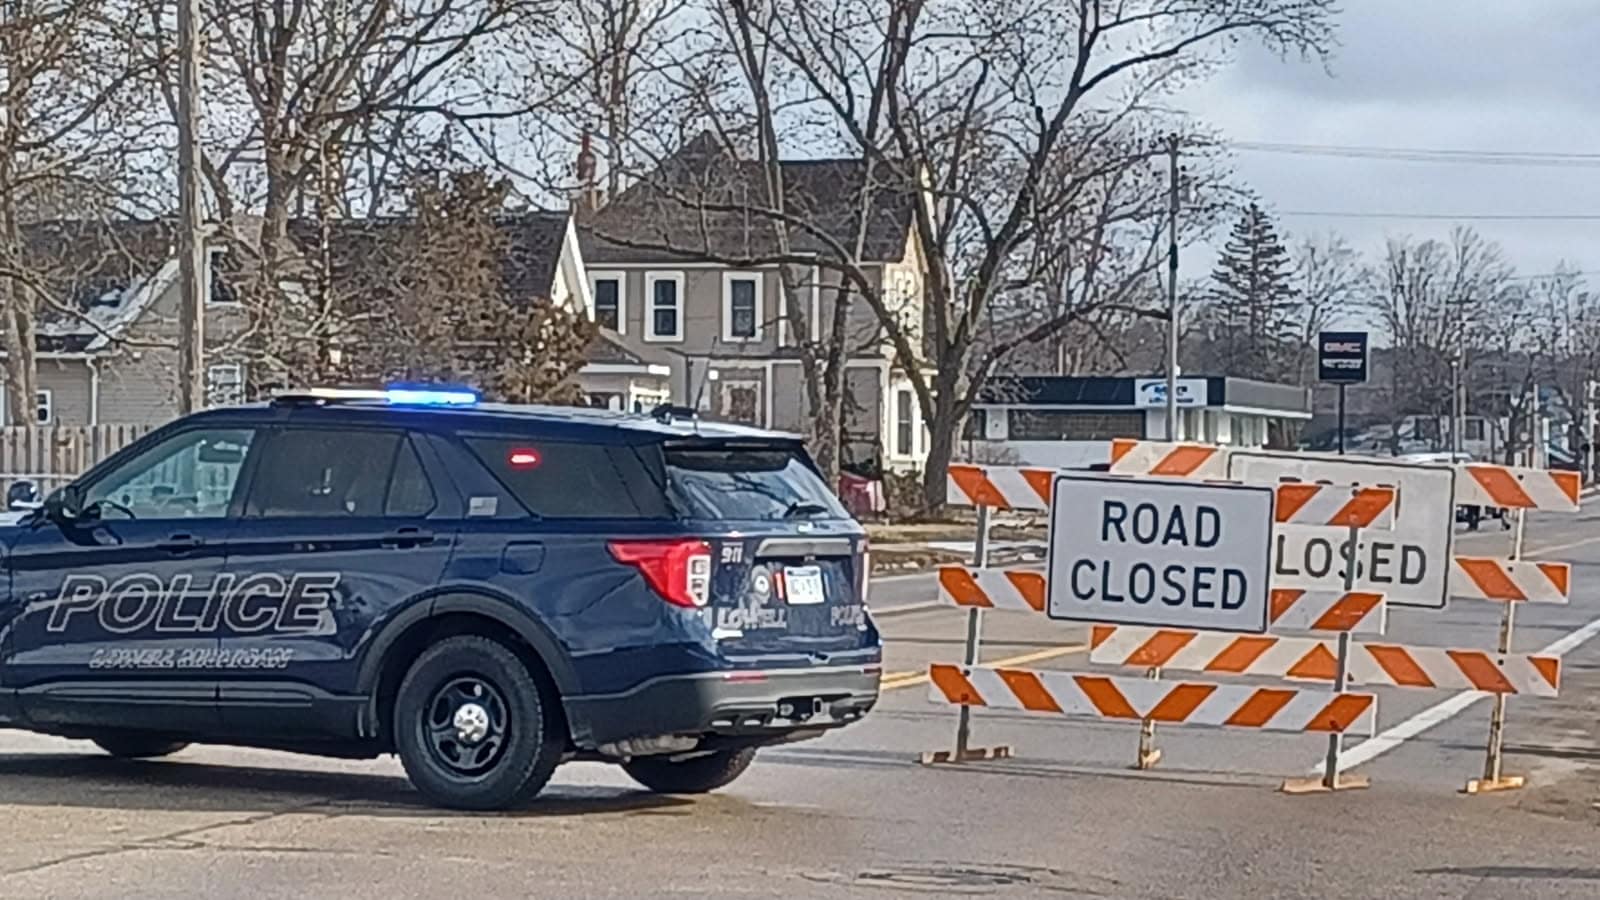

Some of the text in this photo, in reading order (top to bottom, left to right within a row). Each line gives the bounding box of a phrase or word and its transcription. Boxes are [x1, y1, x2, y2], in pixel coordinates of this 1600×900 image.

[1102, 500, 1221, 548] ROAD
[1071, 559, 1248, 610] CLOSED
[1275, 534, 1427, 585] LOSED
[47, 571, 341, 633] POLICE
